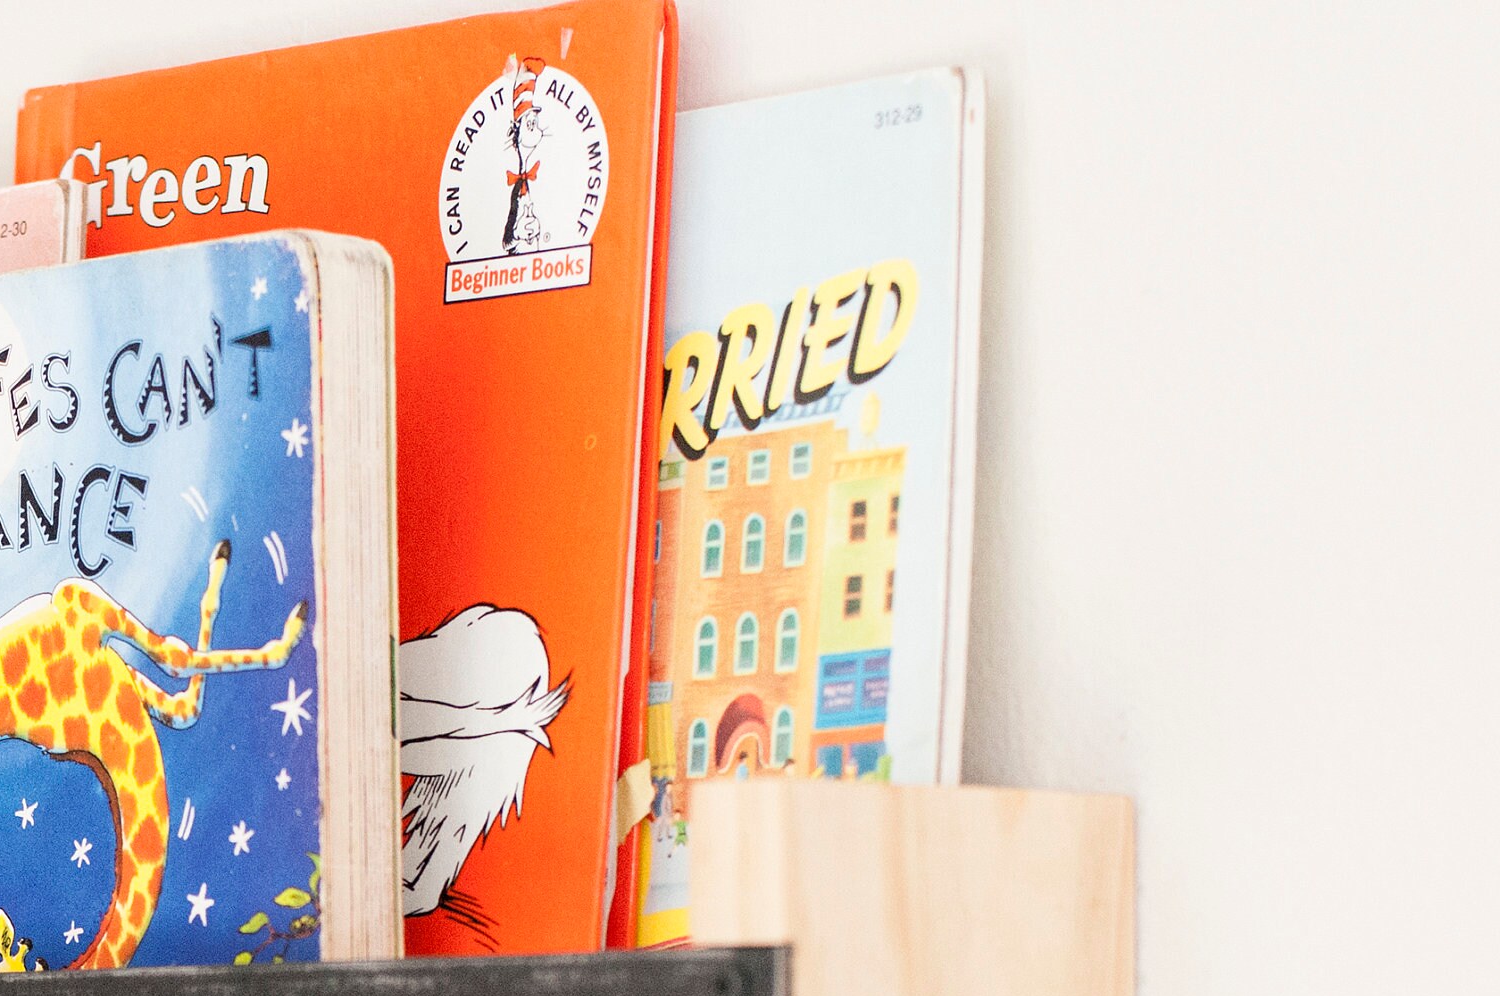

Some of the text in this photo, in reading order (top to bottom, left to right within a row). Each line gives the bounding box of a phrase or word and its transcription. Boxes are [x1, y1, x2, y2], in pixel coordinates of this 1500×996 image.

[490, 87, 505, 111] IT
[545, 79, 575, 110] ALL
[450, 109, 486, 172] READ
[575, 105, 597, 134] BY
[446, 186, 463, 236] CAN
[576, 140, 603, 238] MYSELF
[450, 253, 585, 295] Beginner Books
[102, 312, 275, 447] CAN'T
